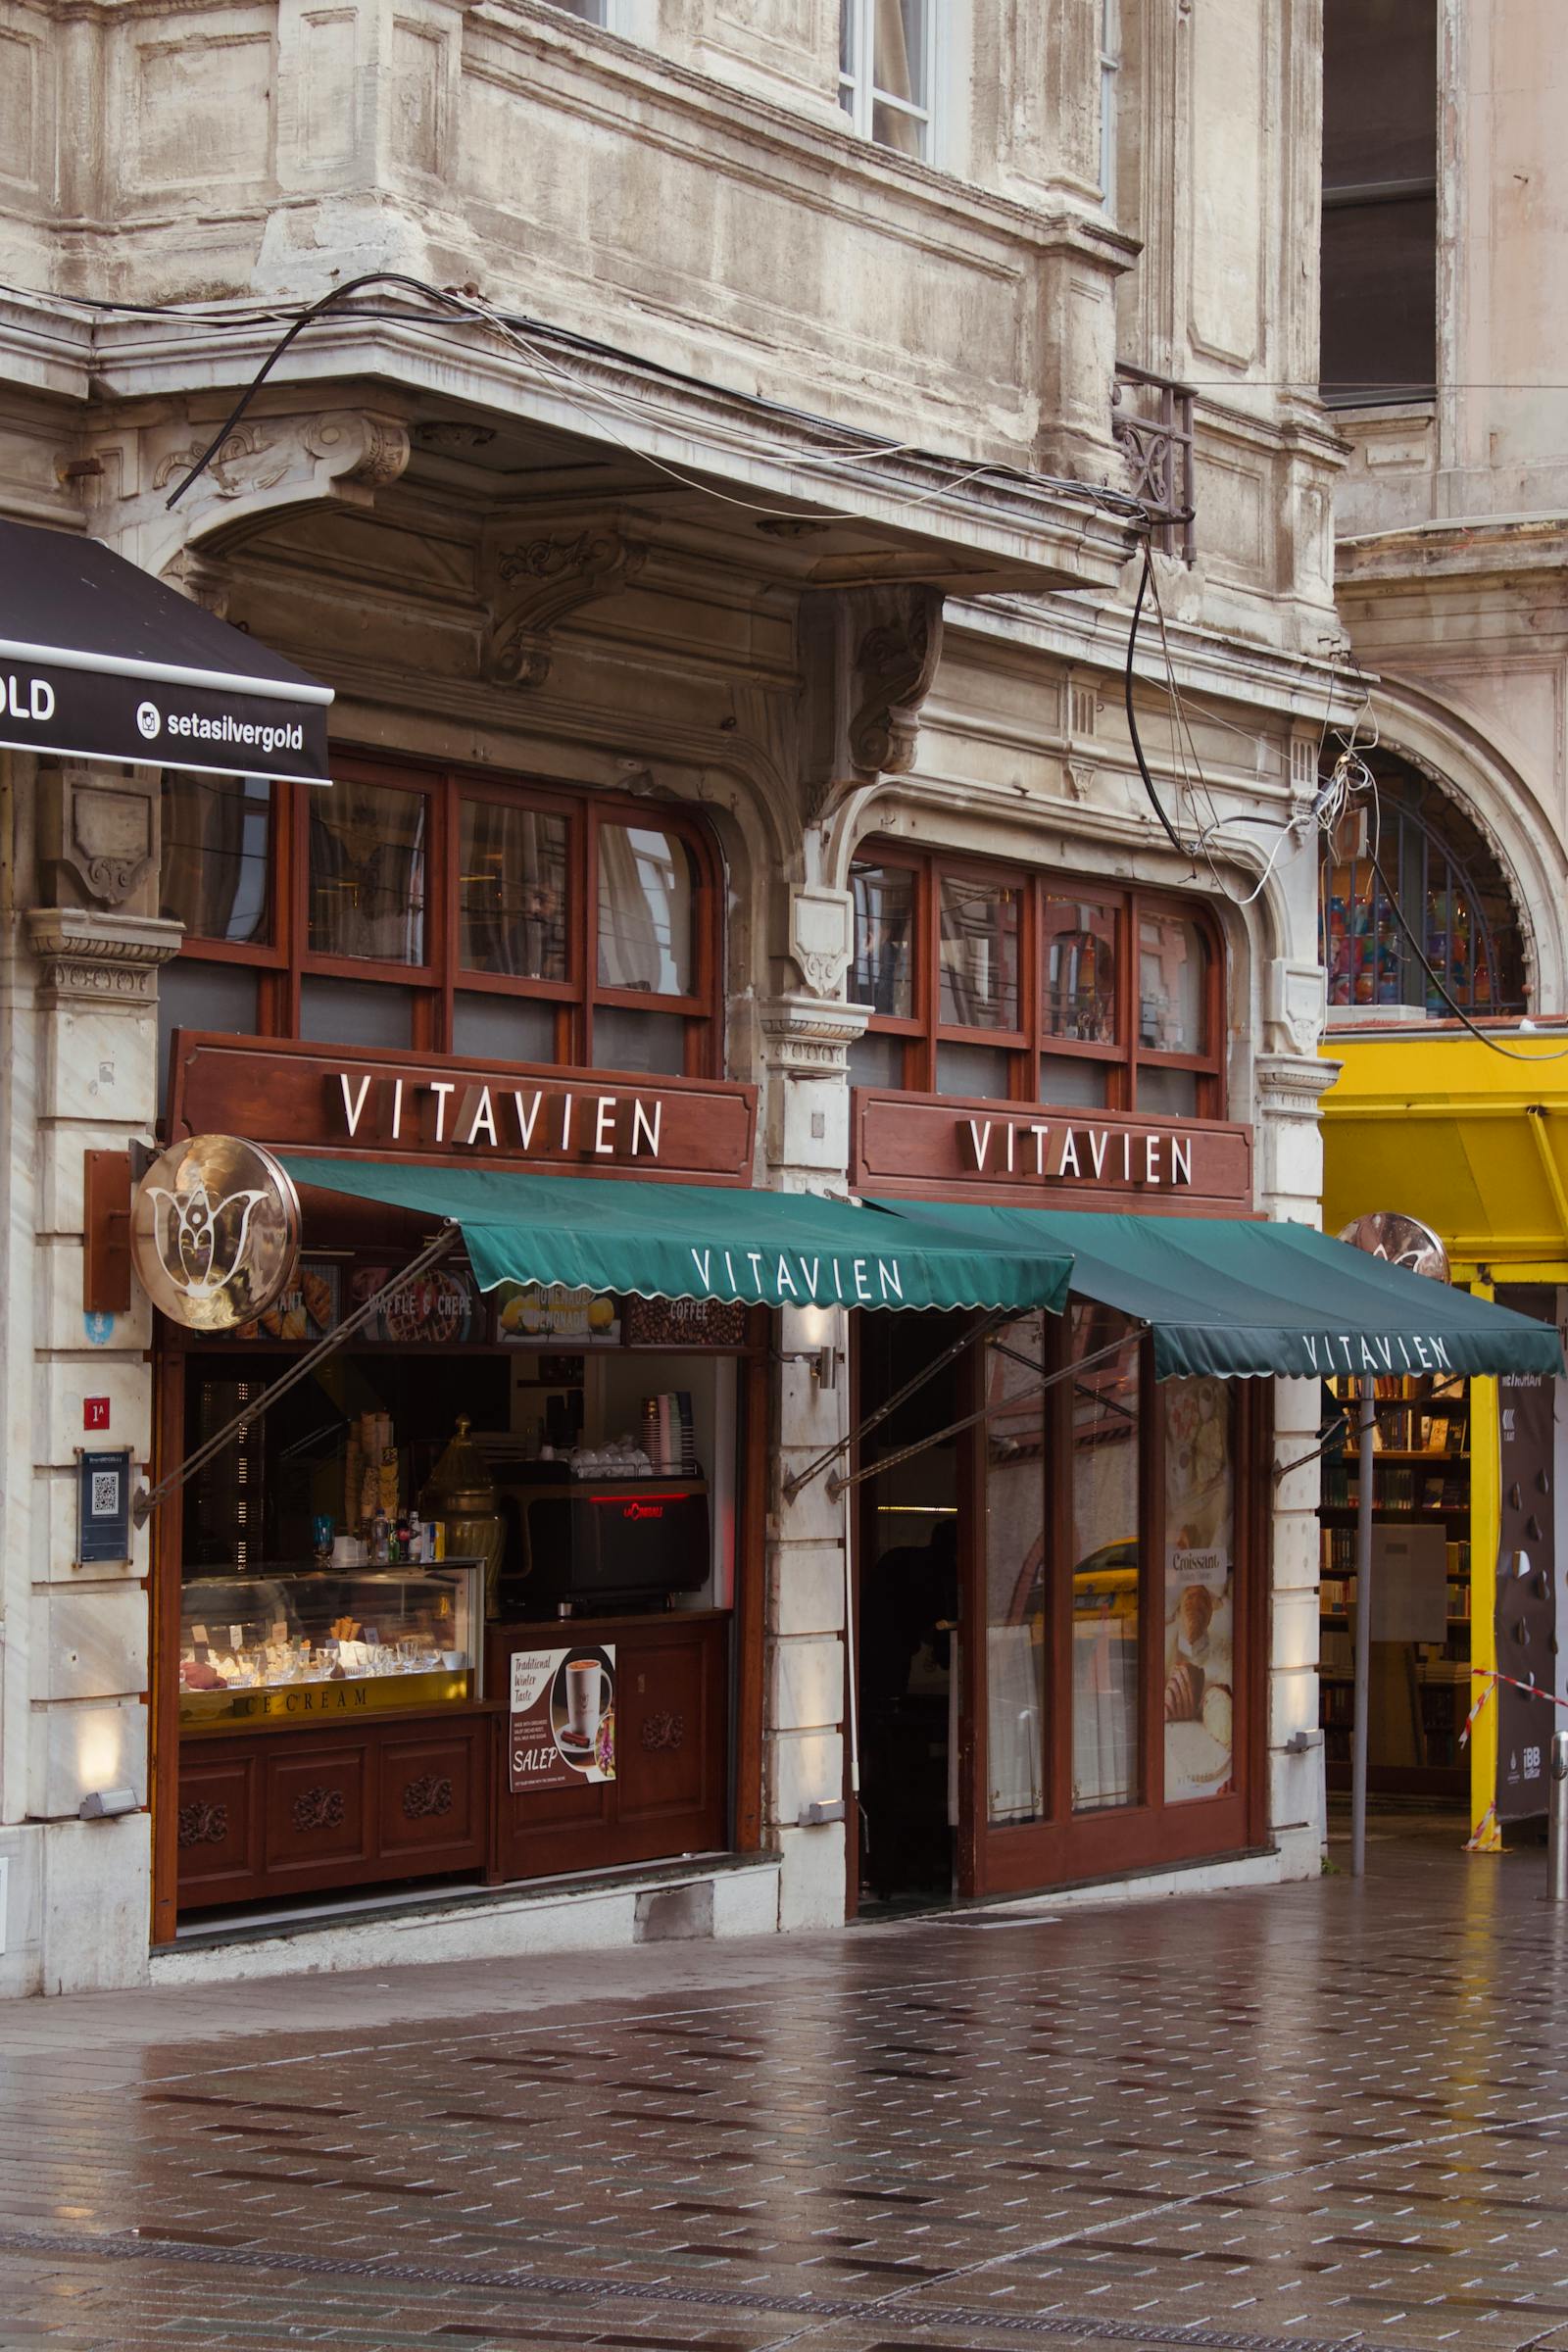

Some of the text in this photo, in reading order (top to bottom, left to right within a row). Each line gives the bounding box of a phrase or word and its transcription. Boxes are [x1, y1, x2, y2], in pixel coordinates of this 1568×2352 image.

[0, 673, 56, 721] LD
[167, 712, 304, 754] setasilvergold
[340, 1073, 662, 1157] VITAVIEN
[970, 1119, 1192, 1186] VITAVIEN
[690, 1248, 904, 1300] VITAVIEN
[437, 1294, 472, 1316] CREPE
[670, 1301, 709, 1321] COFFEE
[1301, 1335, 1452, 1370] VITAVIEN
[1173, 1552, 1220, 1571] Croissant
[515, 1654, 552, 1672] Traditional
[514, 1674, 536, 1687] Winter
[231, 1688, 368, 1715] ICE CREAM
[514, 1690, 532, 1703] Taste
[513, 1746, 559, 1772] SALEP
